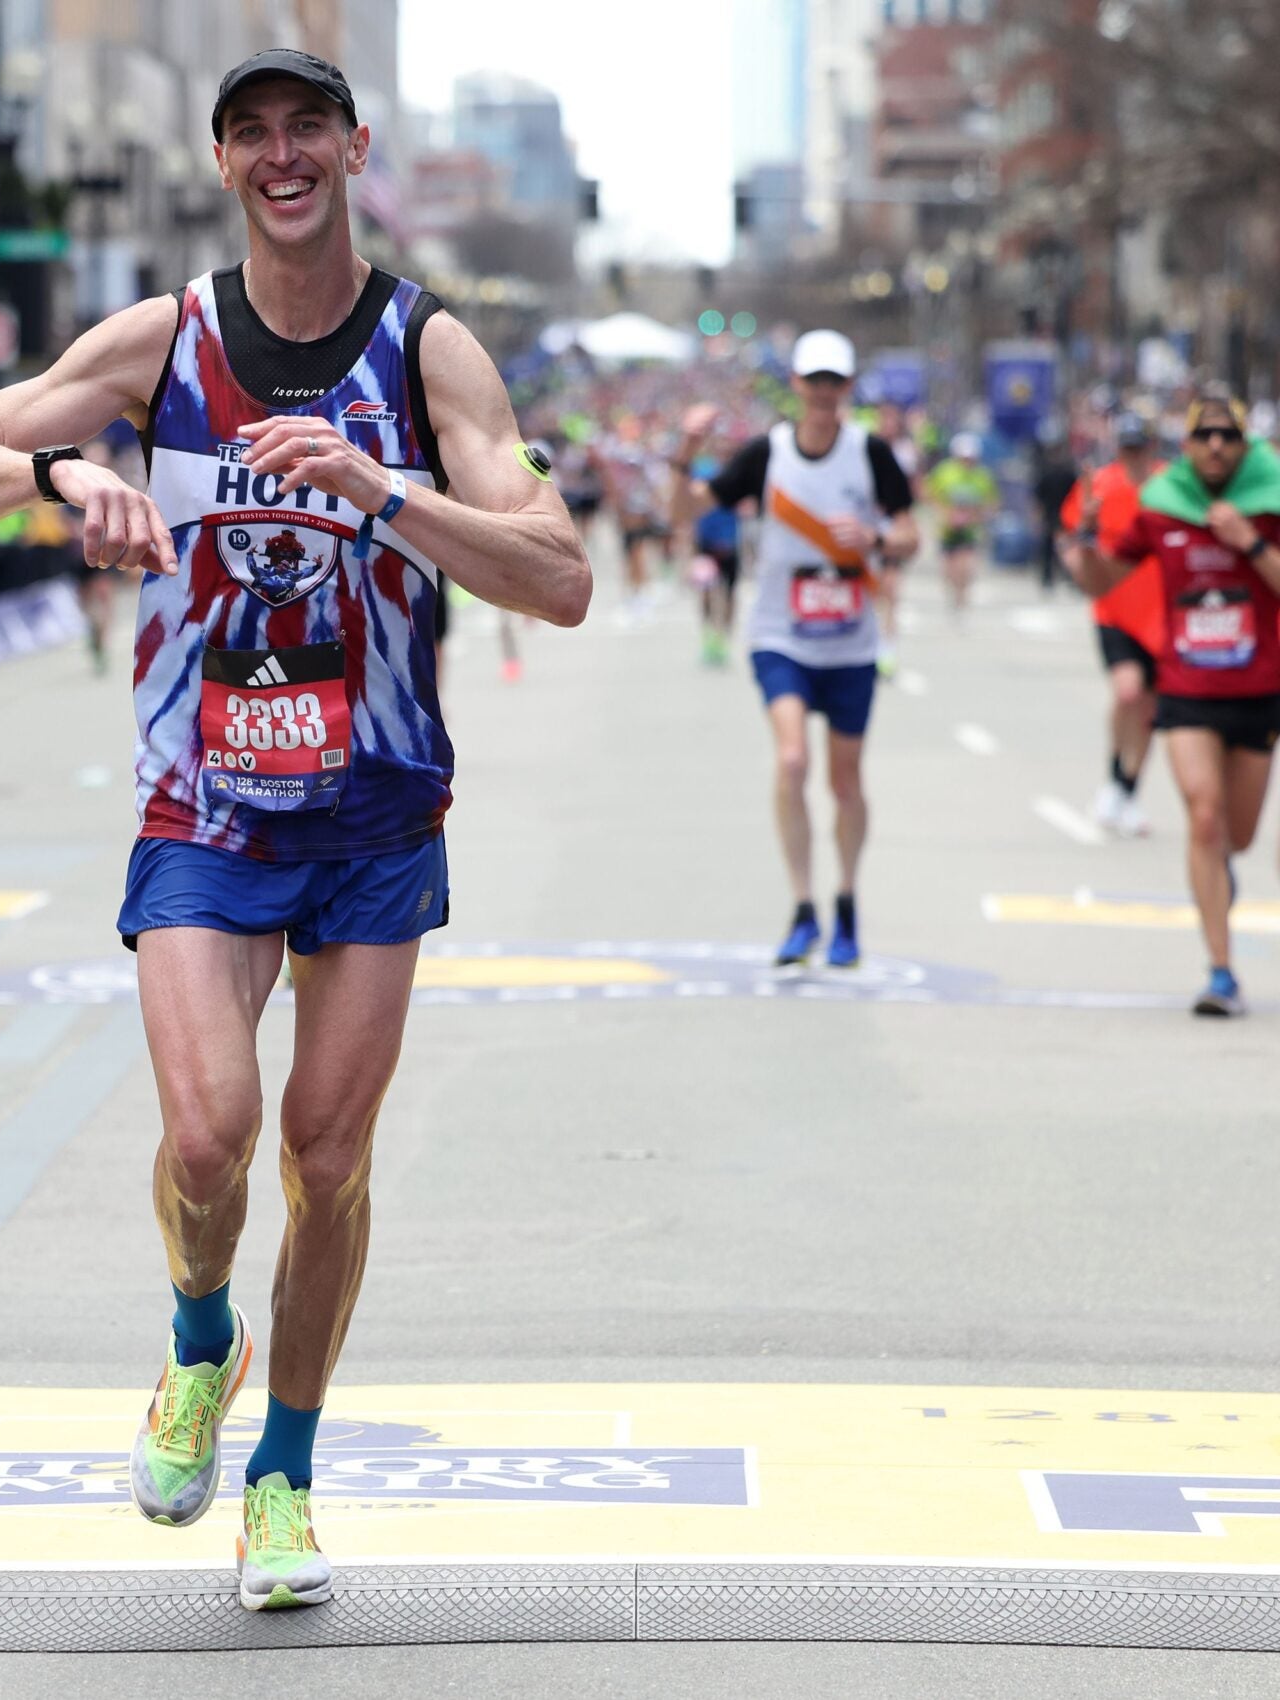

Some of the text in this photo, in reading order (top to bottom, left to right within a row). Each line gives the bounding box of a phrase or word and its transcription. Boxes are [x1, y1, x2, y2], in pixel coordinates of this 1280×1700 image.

[272, 387, 325, 398] Isadore
[341, 411, 397, 422] ATHLETICS EAST
[240, 512, 270, 520] BOSTON
[272, 513, 309, 523] TOGETHER
[316, 520, 334, 529] 2014
[232, 532, 247, 544] 10
[225, 692, 327, 750] 3333
[210, 752, 253, 769] 4 V
[261, 778, 304, 788] BOSTON
[236, 787, 305, 798] MARATHON
